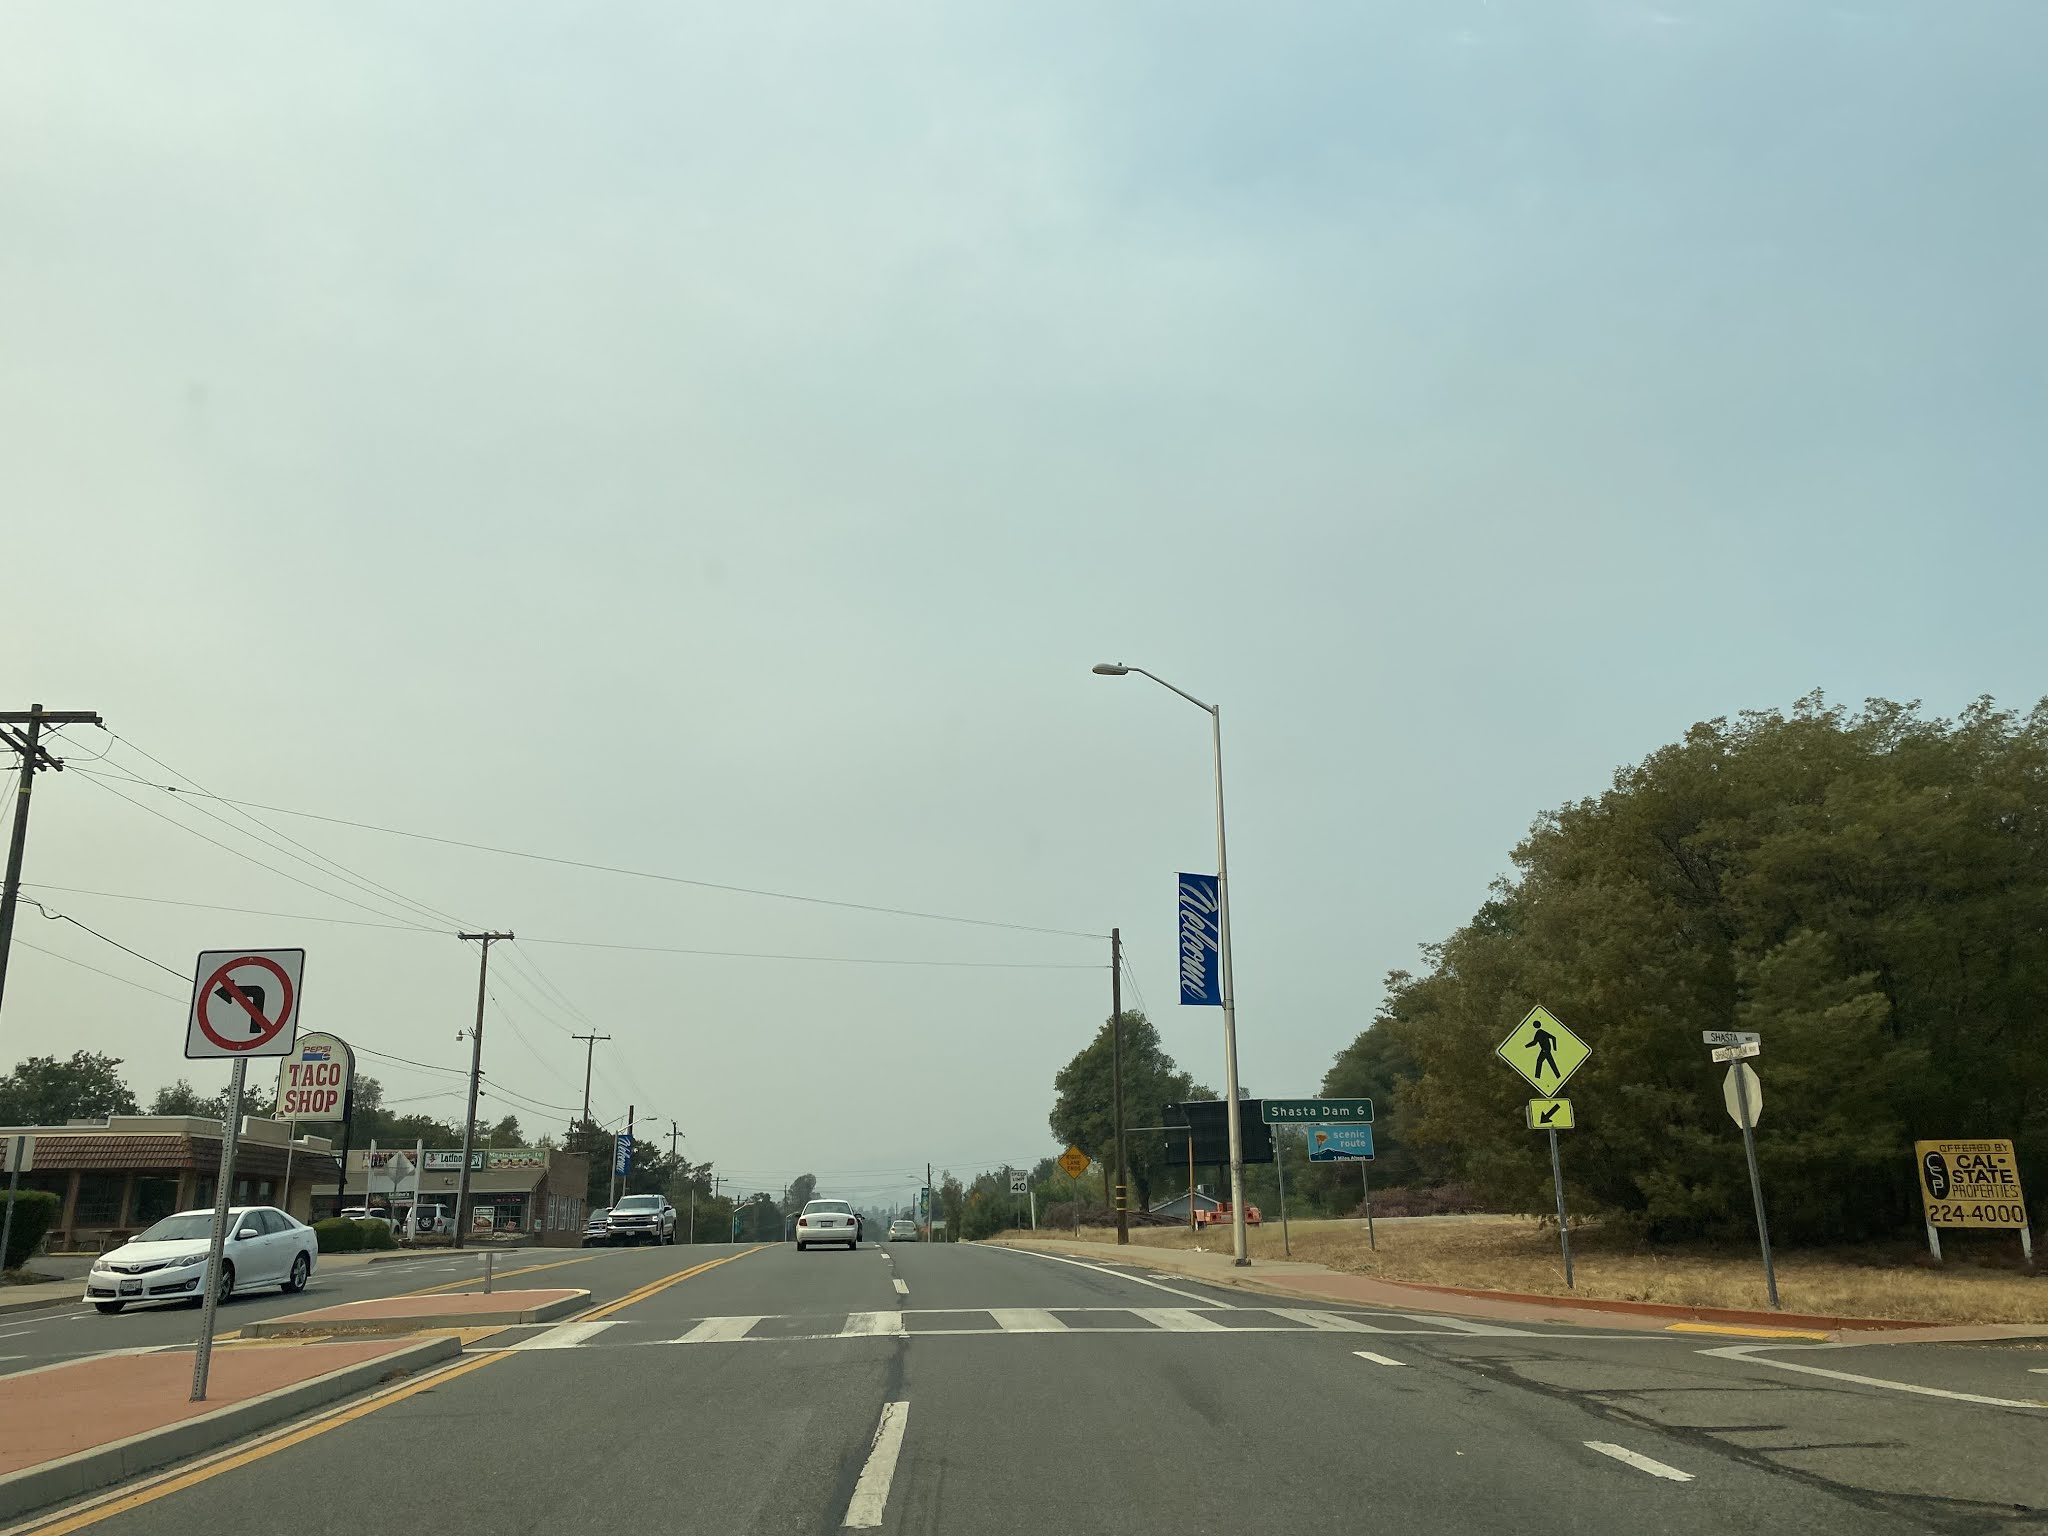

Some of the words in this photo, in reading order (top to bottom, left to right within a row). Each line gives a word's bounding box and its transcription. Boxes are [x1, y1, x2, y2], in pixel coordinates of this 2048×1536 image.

[1180, 880, 1219, 1001] Welcome
[1710, 1032, 1739, 1043] SHASTA
[303, 1045, 332, 1053] PEPSI
[288, 1063, 341, 1087] TACO
[284, 1089, 338, 1113] SHOP
[1271, 1106, 1316, 1117] Shasta
[1322, 1106, 1350, 1116] Dam
[1357, 1105, 1365, 1115] 6
[1333, 1130, 1365, 1139] scenic
[1340, 1139, 1366, 1148] route
[1939, 1143, 1990, 1153] OFFERED
[1994, 1143, 2008, 1152] BY
[1956, 1154, 2007, 1169] CAL-
[1952, 1169, 2014, 1184] STATE
[1011, 1182, 1027, 1191] 40
[1951, 1184, 2019, 1198] PROPERTIES
[1928, 1204, 2024, 1223] 224-4000
